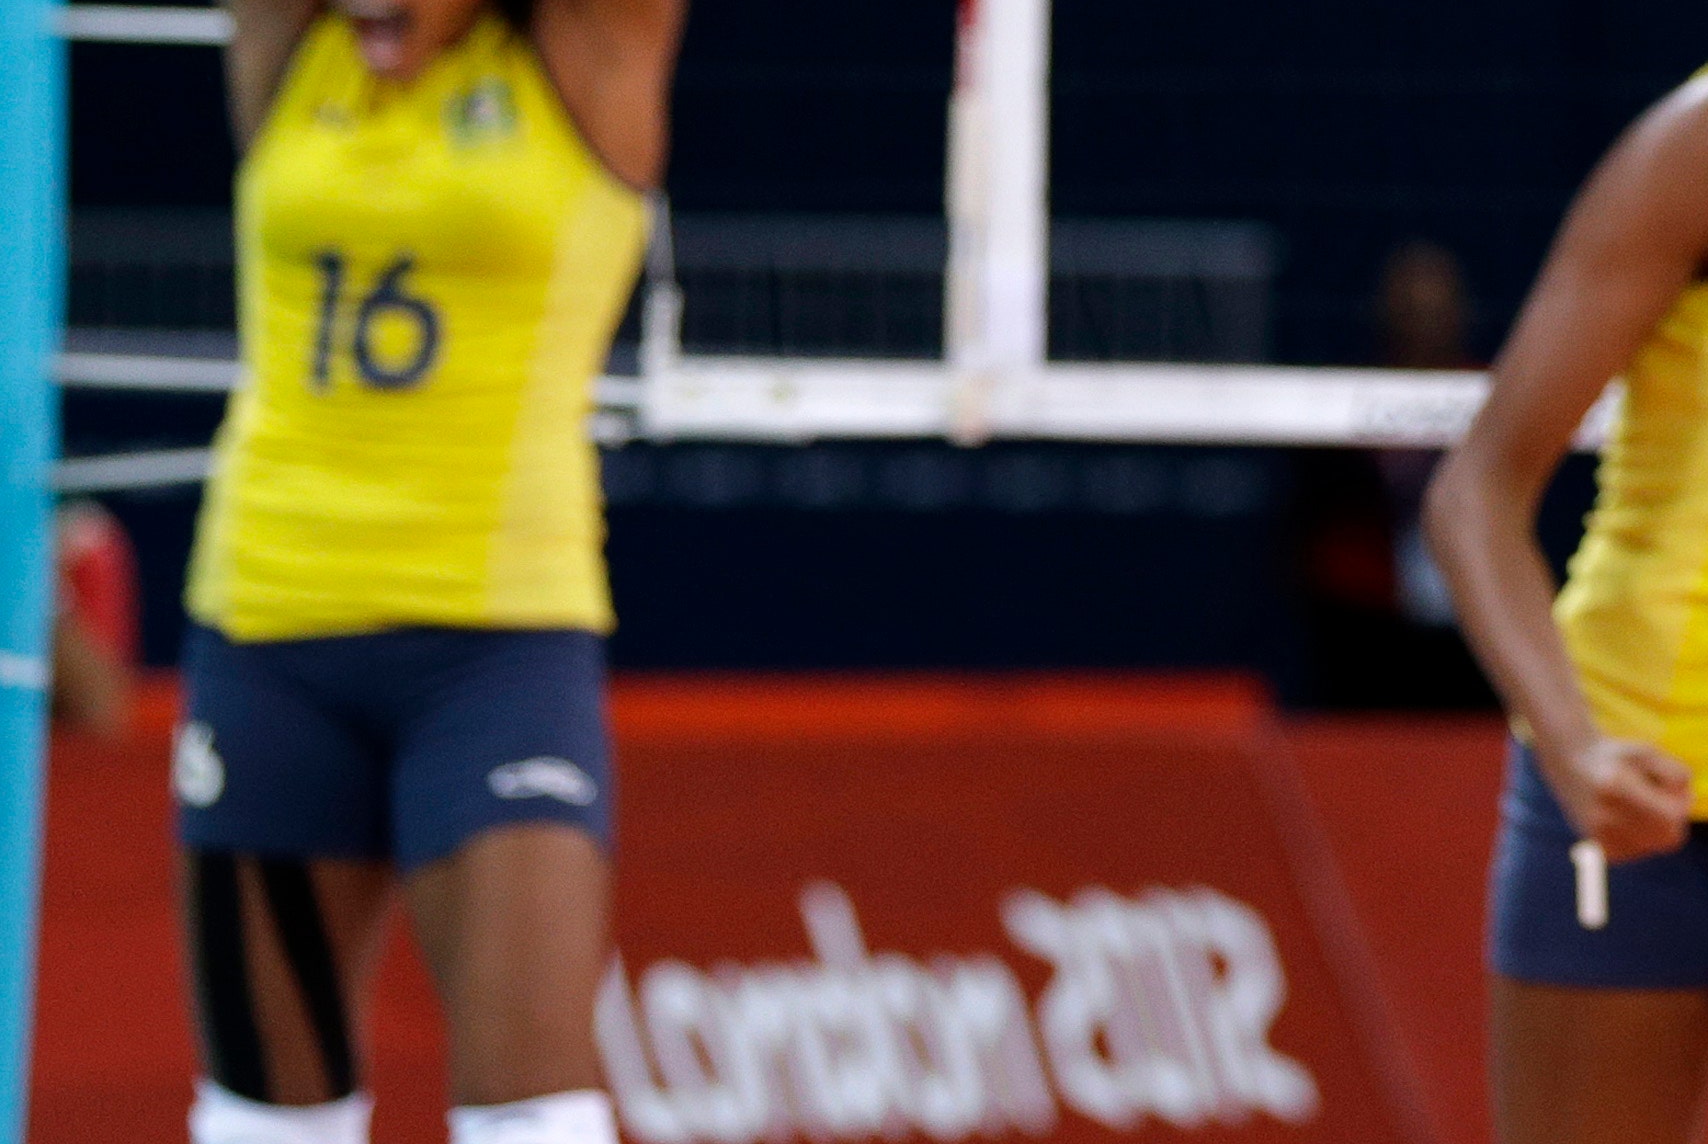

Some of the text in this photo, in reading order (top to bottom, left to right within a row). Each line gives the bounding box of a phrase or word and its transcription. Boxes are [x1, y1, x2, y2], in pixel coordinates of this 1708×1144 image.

[312, 247, 442, 394] 16
[1569, 839, 1611, 930] 1
[596, 880, 1320, 1140] London 2012
